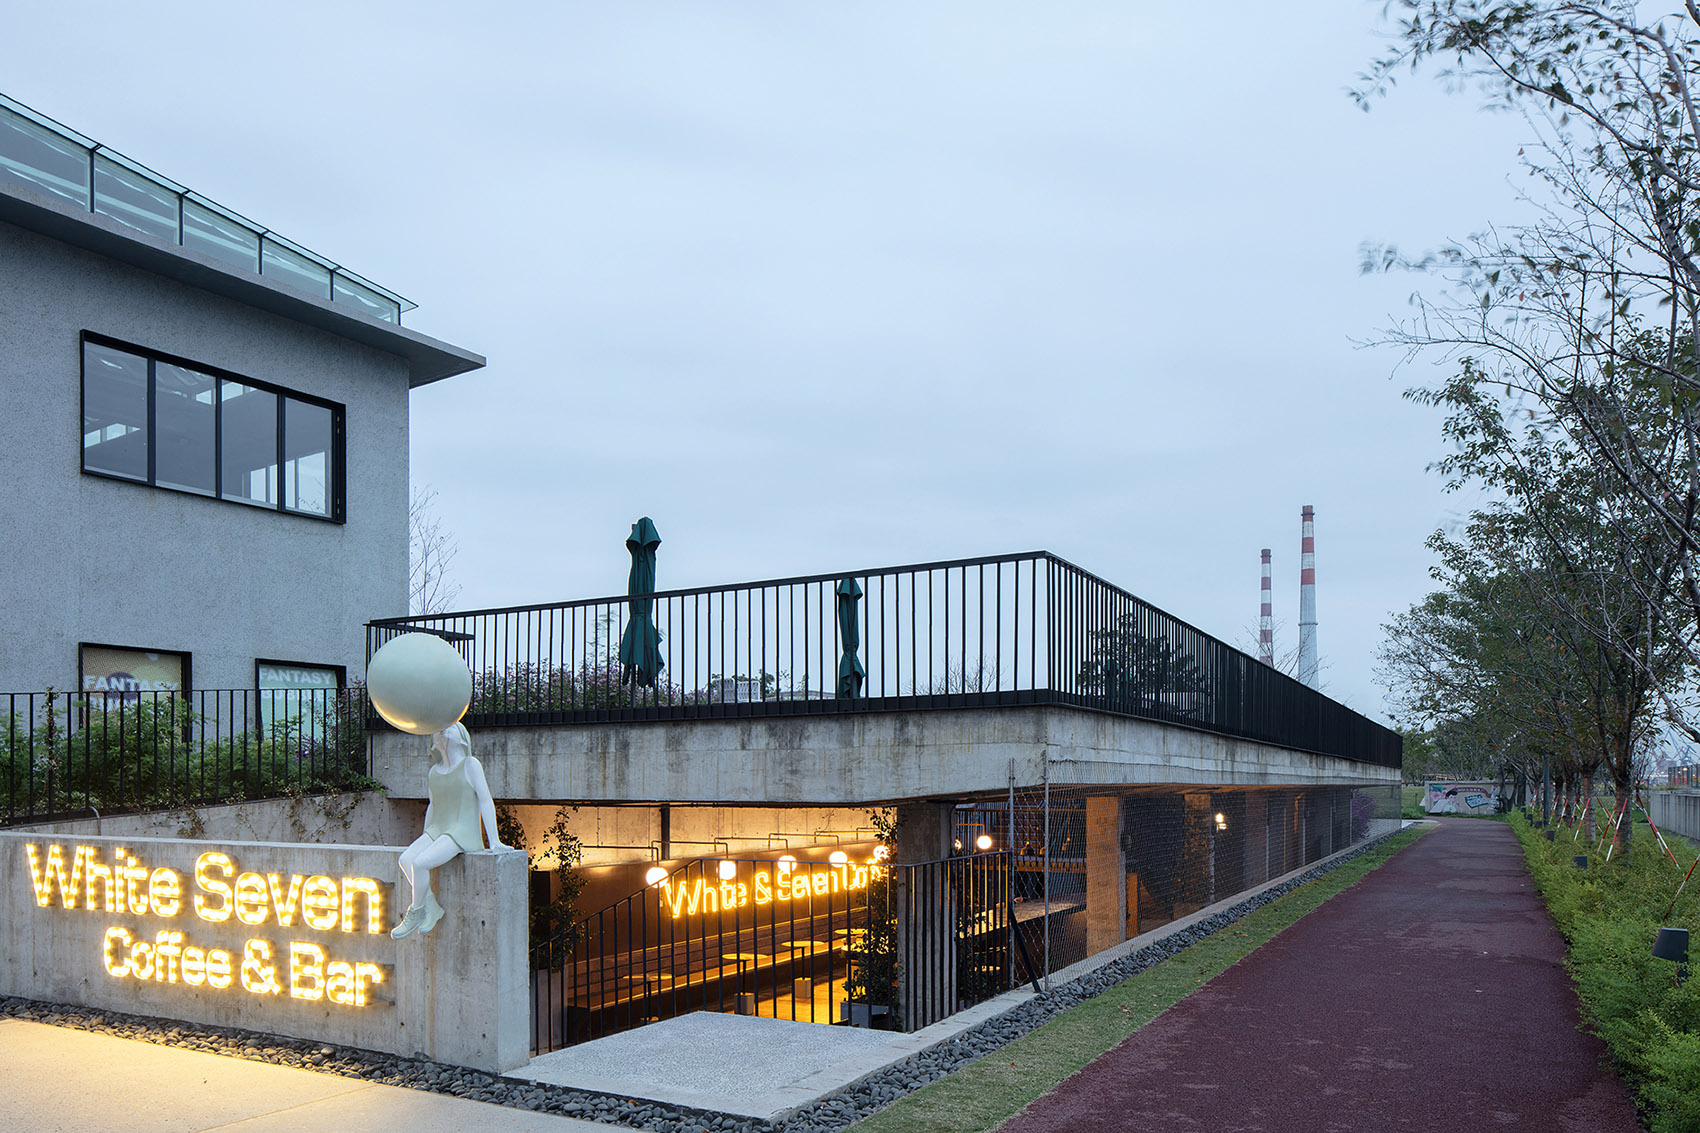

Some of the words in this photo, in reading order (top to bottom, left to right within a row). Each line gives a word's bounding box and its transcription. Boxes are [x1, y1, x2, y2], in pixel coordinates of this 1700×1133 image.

[83, 675, 179, 692] FANTASY
[260, 667, 331, 684] FANTASY
[26, 843, 181, 917] White
[194, 851, 382, 934] Seven
[665, 879, 747, 918] Whte
[754, 871, 772, 905] &
[103, 926, 231, 988] Coffee
[241, 938, 281, 995] &
[289, 940, 384, 1007] Bar
